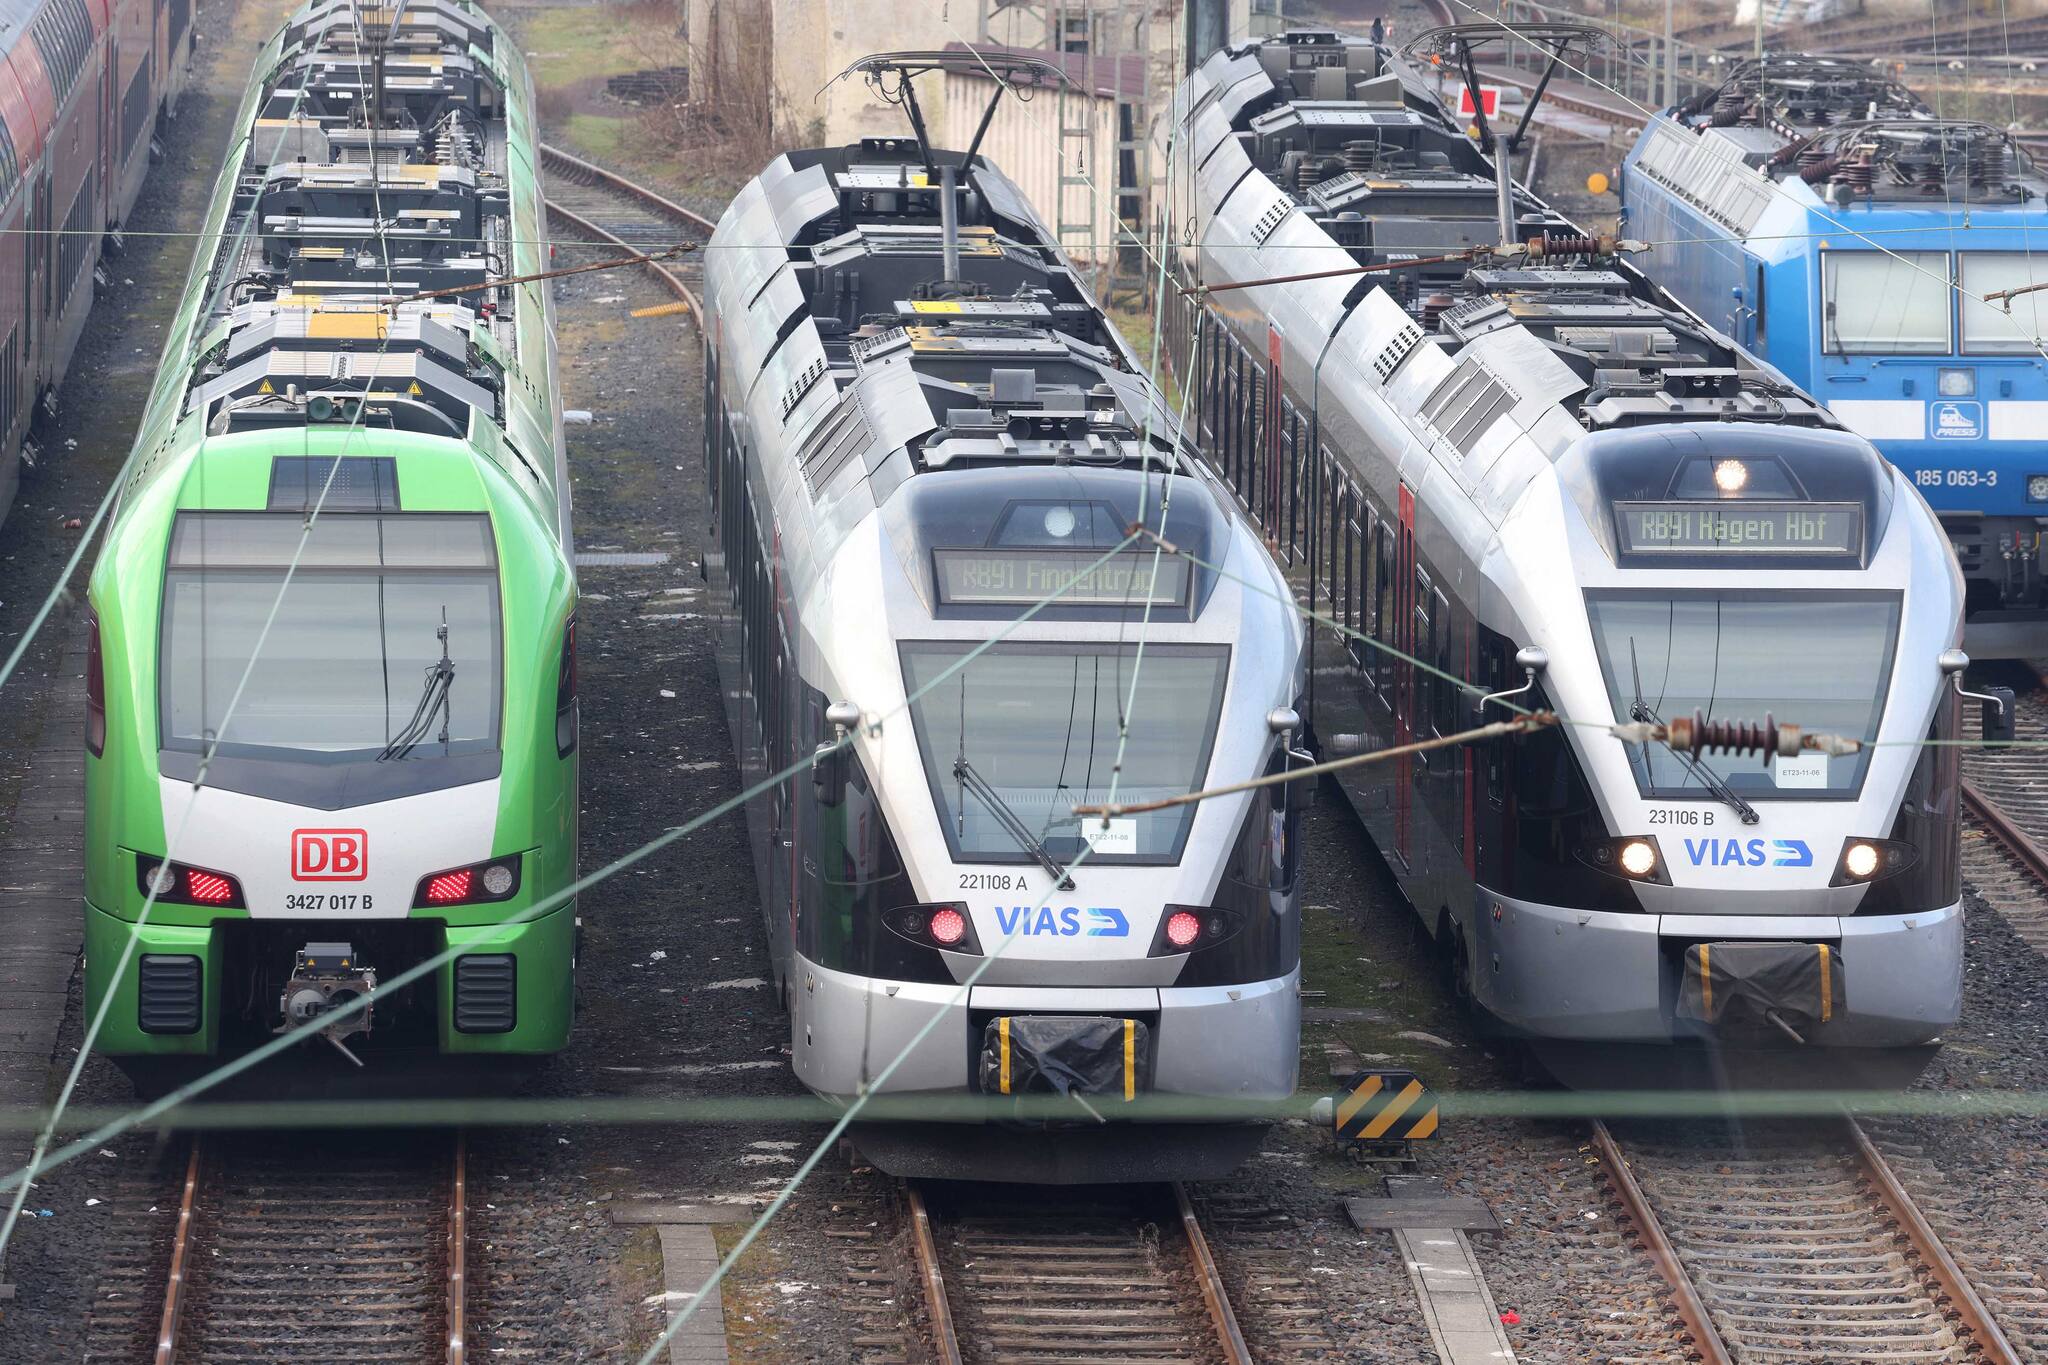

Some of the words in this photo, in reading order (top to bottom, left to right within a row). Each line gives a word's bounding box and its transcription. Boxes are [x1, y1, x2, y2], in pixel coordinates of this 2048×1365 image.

[1936, 428, 1978, 436] PRESS
[1915, 470, 1942, 486] 185
[1947, 470, 1998, 486] 063-3
[1641, 511, 1691, 540] RB91
[1699, 511, 1774, 543] Hagen
[1786, 511, 1827, 541] Hbf
[963, 560, 1015, 588] RB91
[1649, 809, 1698, 825] 231106
[1703, 811, 1714, 826] B
[300, 836, 360, 874] DB
[1683, 838, 1767, 867] VIAS
[959, 874, 1011, 890] 221108
[1015, 876, 1028, 891] A
[286, 894, 325, 910] 3427
[329, 895, 357, 910] 017
[362, 895, 373, 910] B
[994, 906, 1081, 936] VIAS
